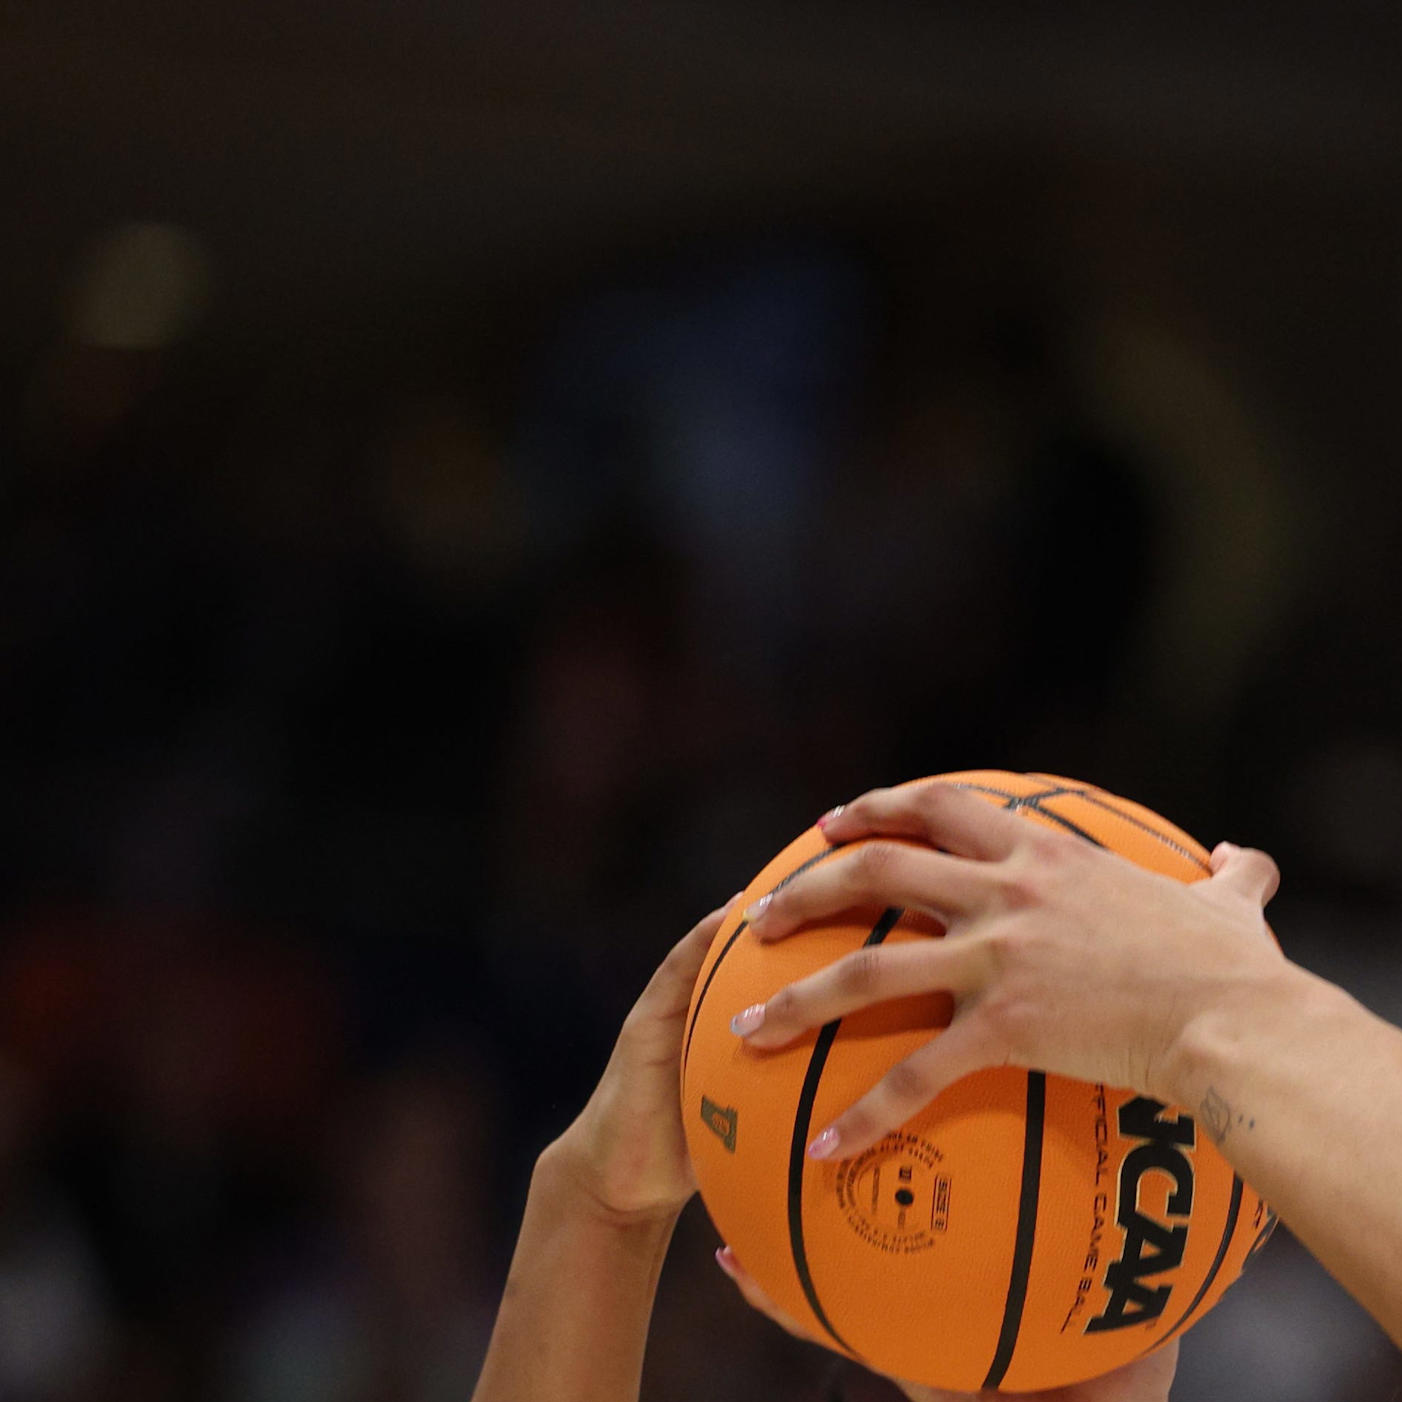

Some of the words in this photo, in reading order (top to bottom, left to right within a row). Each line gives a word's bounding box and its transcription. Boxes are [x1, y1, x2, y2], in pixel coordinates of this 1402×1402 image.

[1083, 1095, 1196, 1336] NCAA
[1083, 1193, 1107, 1272] GAME
[1060, 1278, 1092, 1335] BALL
